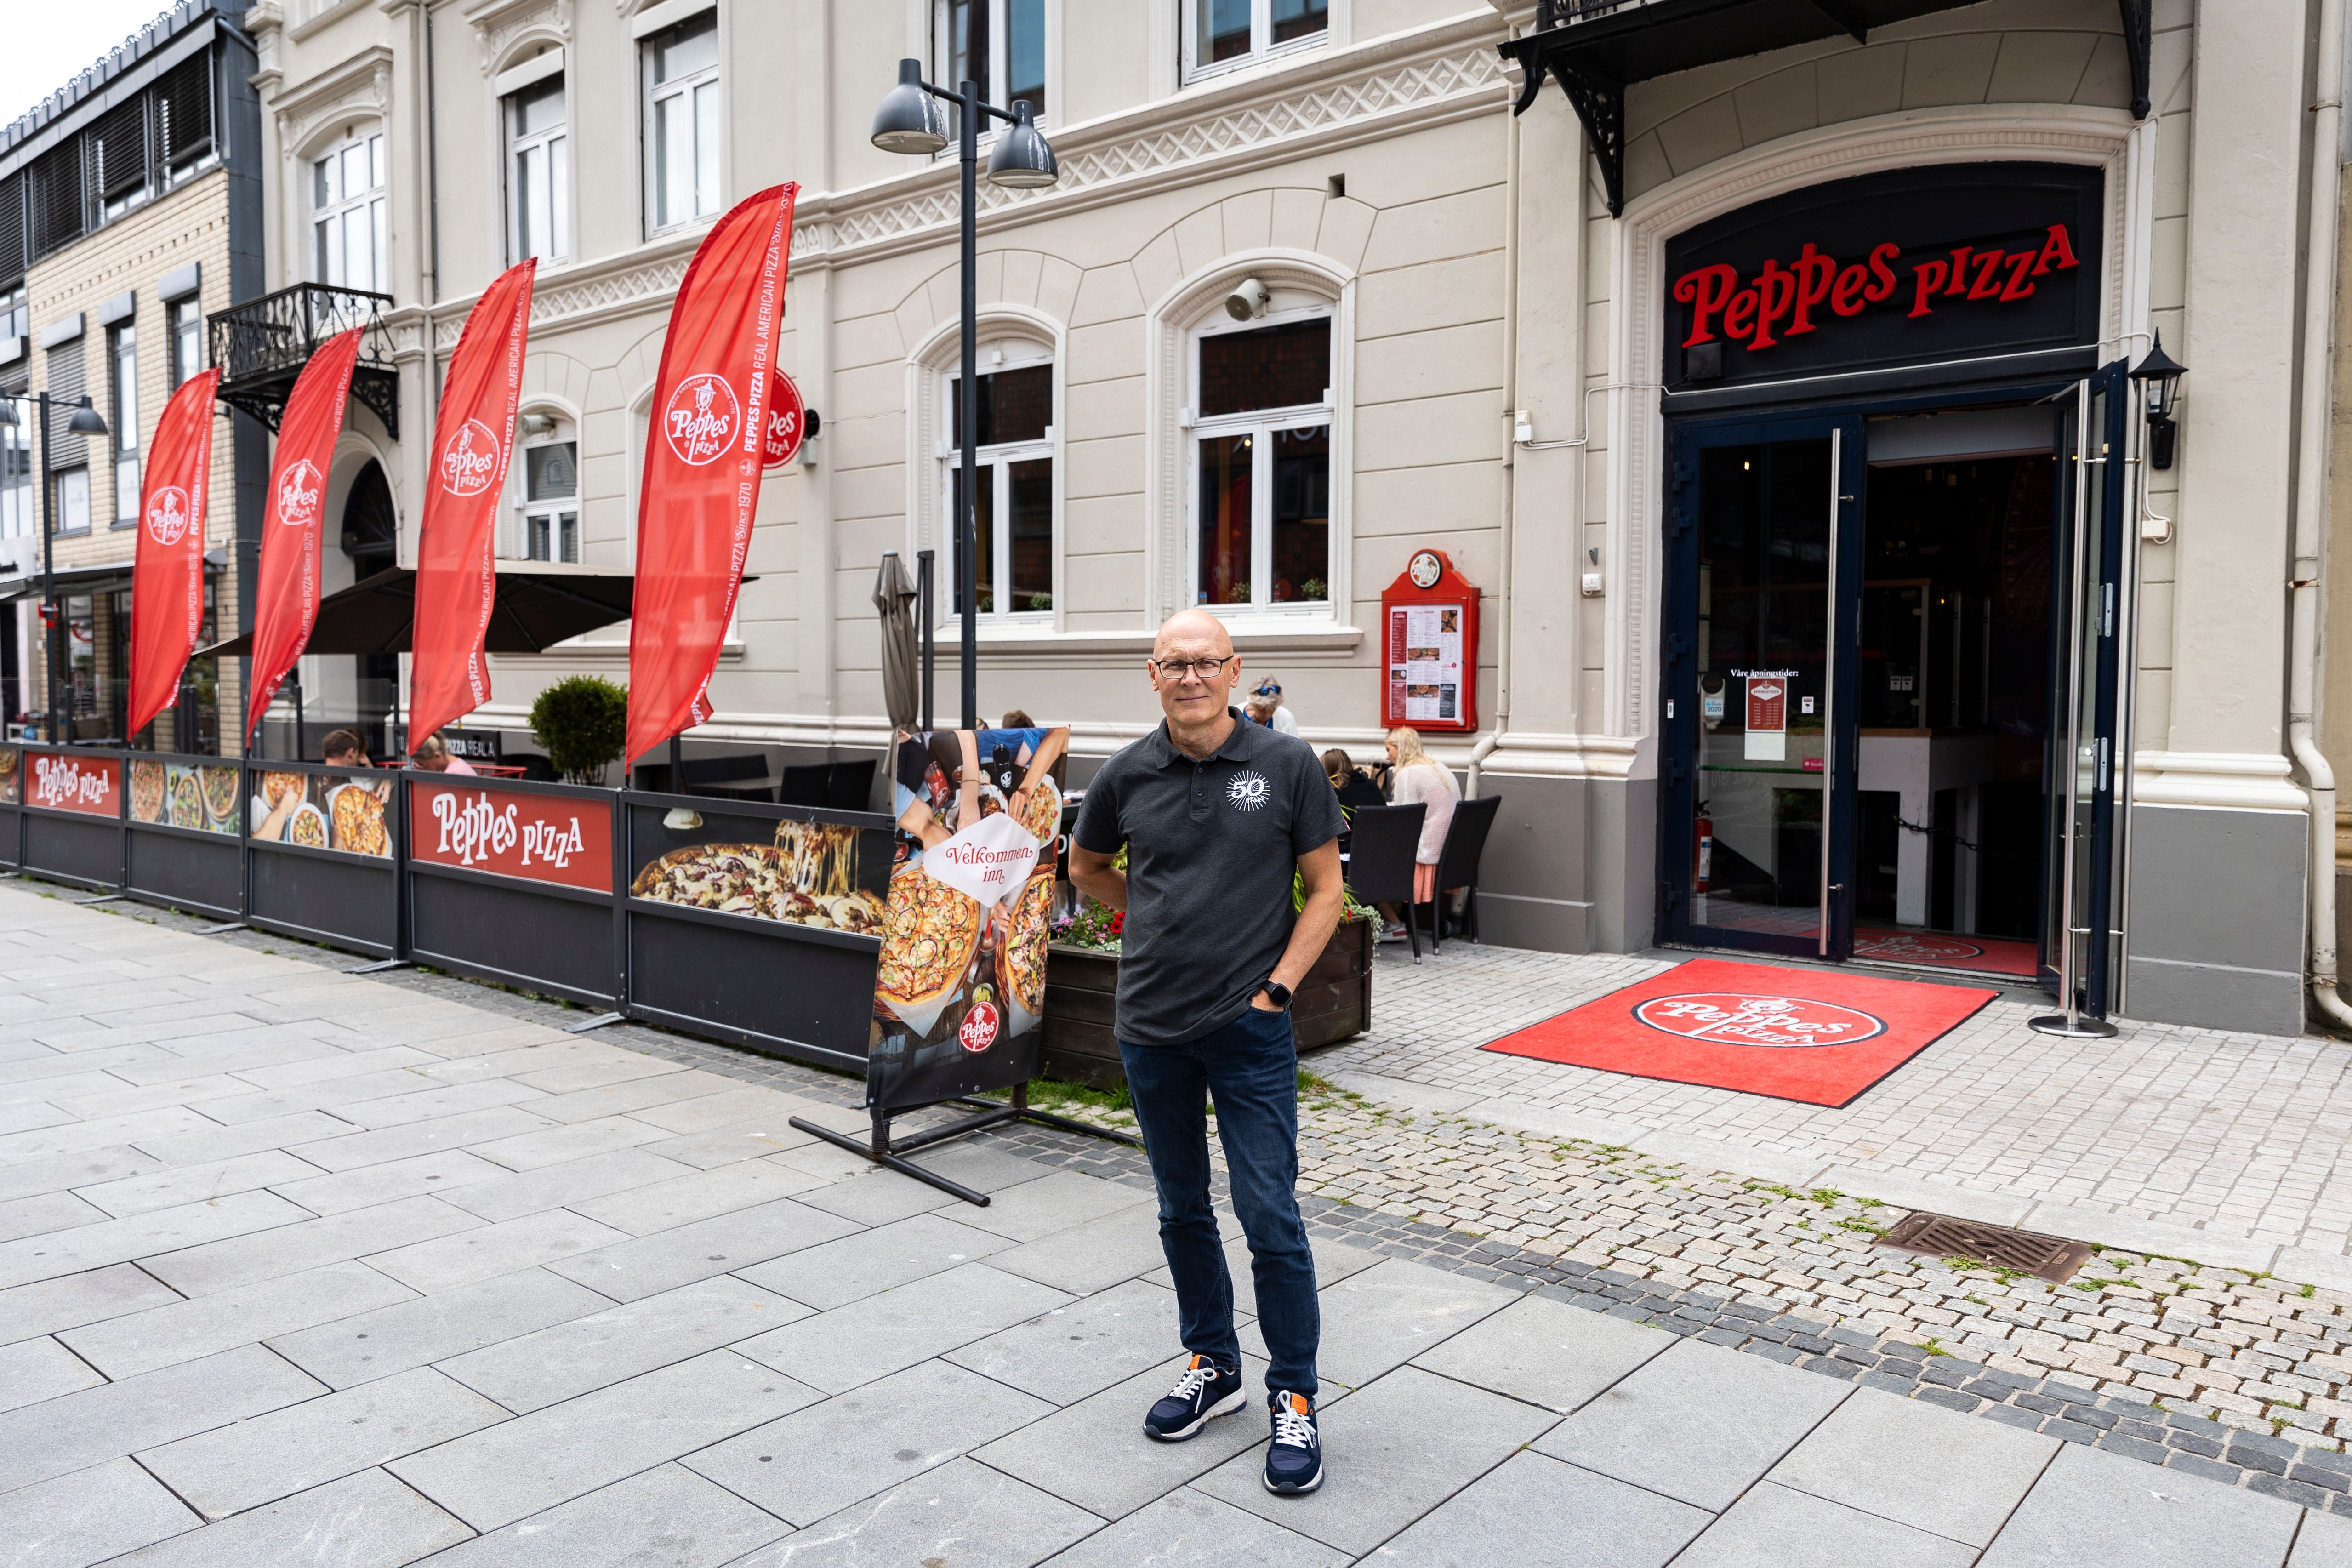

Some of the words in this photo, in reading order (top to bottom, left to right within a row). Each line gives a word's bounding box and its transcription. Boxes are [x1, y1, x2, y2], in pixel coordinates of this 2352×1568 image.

[765, 246, 780, 278] PIZZA
[1673, 242, 1901, 350] Peppes
[1907, 222, 2081, 318] PIZZA
[757, 279, 775, 341] AMERICAN
[508, 340, 521, 389] AMERICAN
[753, 342, 768, 369] REAL
[507, 391, 518, 413] REAL
[749, 372, 765, 406] PIZZA
[505, 415, 515, 443] PIZZA
[670, 410, 730, 441] Peppes
[744, 407, 760, 452] PEPPES
[766, 410, 795, 440] pes
[694, 440, 720, 456] PIZZA
[765, 438, 790, 456] IZZA
[499, 443, 510, 481] PEPPES
[192, 484, 201, 506] PIZZA
[460, 474, 486, 488] PIZZA
[737, 482, 752, 507] 1970
[189, 507, 200, 536] PEPPES
[735, 509, 749, 542] Since
[303, 531, 314, 551] 1970
[188, 553, 199, 570] 1970
[302, 552, 314, 576] Since
[730, 542, 746, 572] PIZZA
[188, 591, 198, 610] PIZZA
[302, 576, 313, 598] PIZZA
[188, 611, 198, 646] AMERICAN
[301, 598, 313, 637] AMERICAN
[468, 651, 478, 681] PIZZA
[479, 582, 491, 629] AMERICAN
[1750, 669, 1799, 679] åpningstider:
[35, 755, 80, 805] Peppes
[79, 768, 109, 806] PIZZA
[1231, 779, 1264, 798] 50
[433, 792, 518, 866] Peppes
[522, 817, 584, 868] PIZZA
[945, 842, 1033, 865] Velkommen
[982, 866, 1005, 884] inn
[962, 1021, 996, 1040] Peppes
[1656, 1001, 1853, 1034] Peppes
[1707, 1024, 1816, 1044] PIZZA
